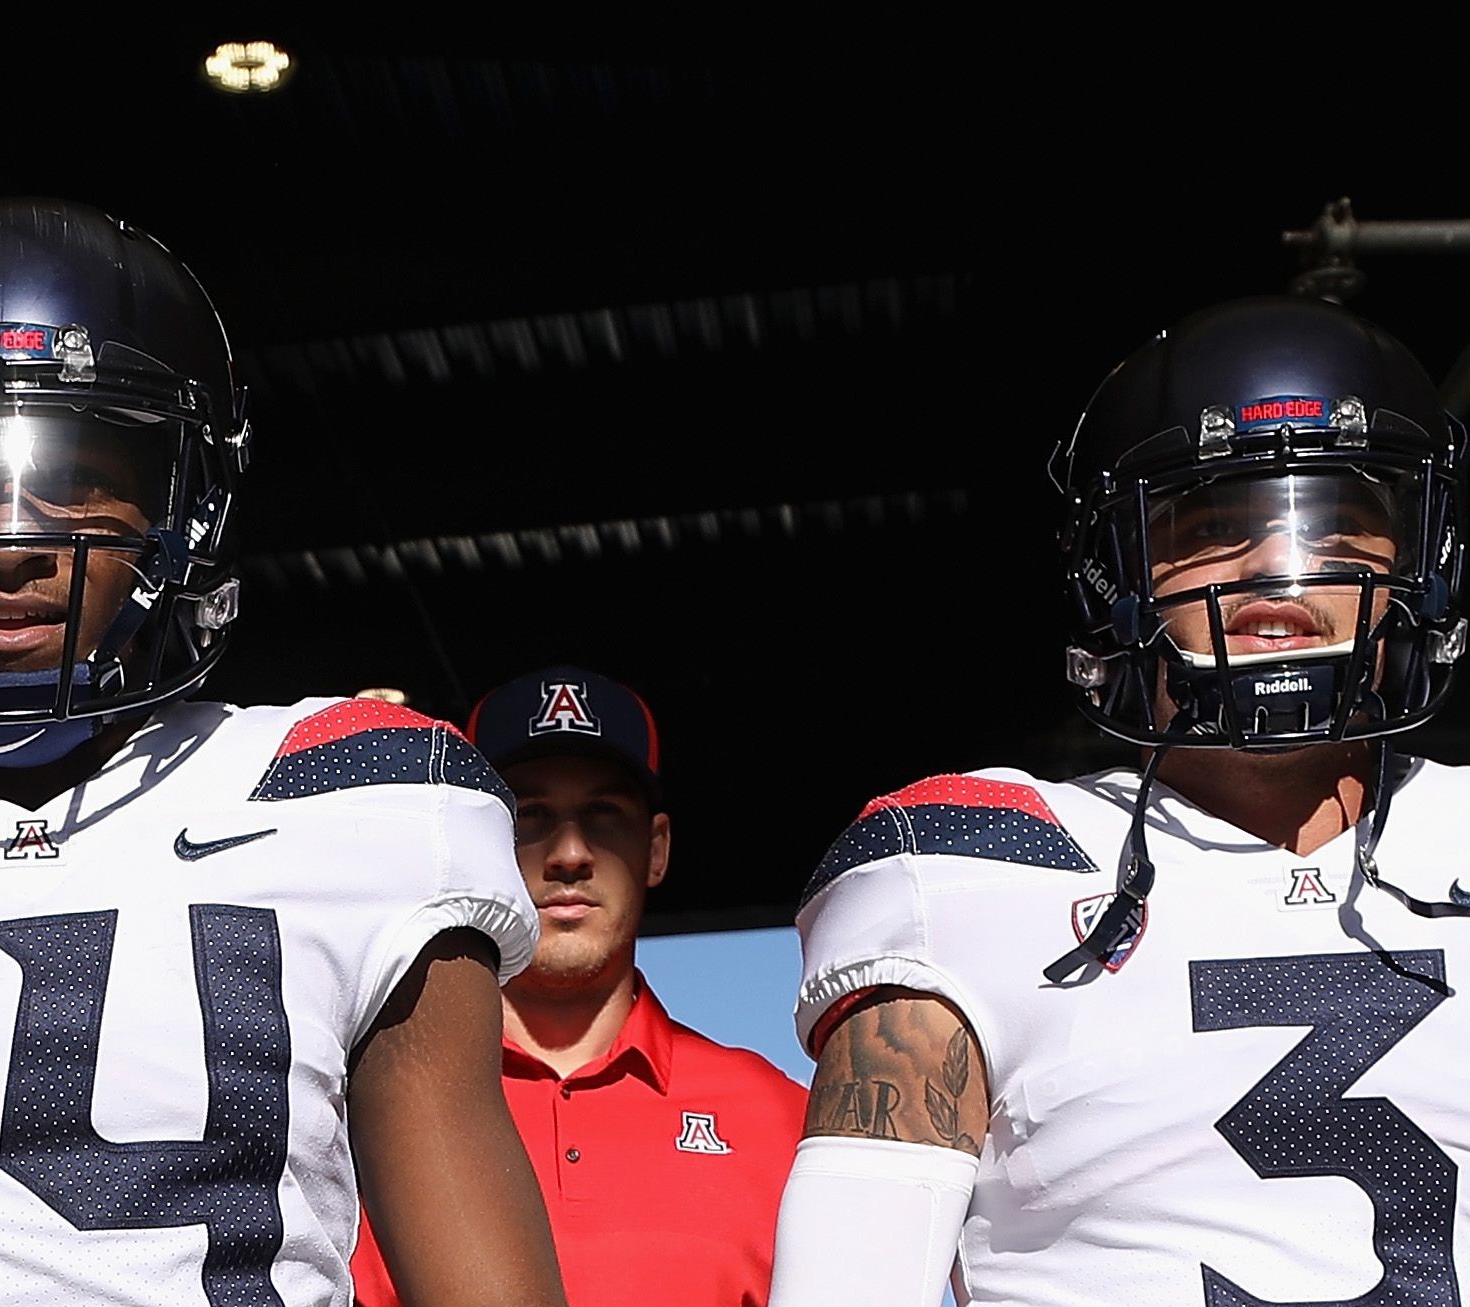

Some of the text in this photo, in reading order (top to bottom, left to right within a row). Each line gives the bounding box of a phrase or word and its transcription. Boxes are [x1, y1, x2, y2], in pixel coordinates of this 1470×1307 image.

[3, 328, 45, 350] EDGE
[1241, 401, 1322, 422] HARD EDGE
[529, 680, 601, 736] A
[4, 820, 59, 860] A
[1284, 867, 1336, 905] A
[675, 1111, 729, 1154] A
